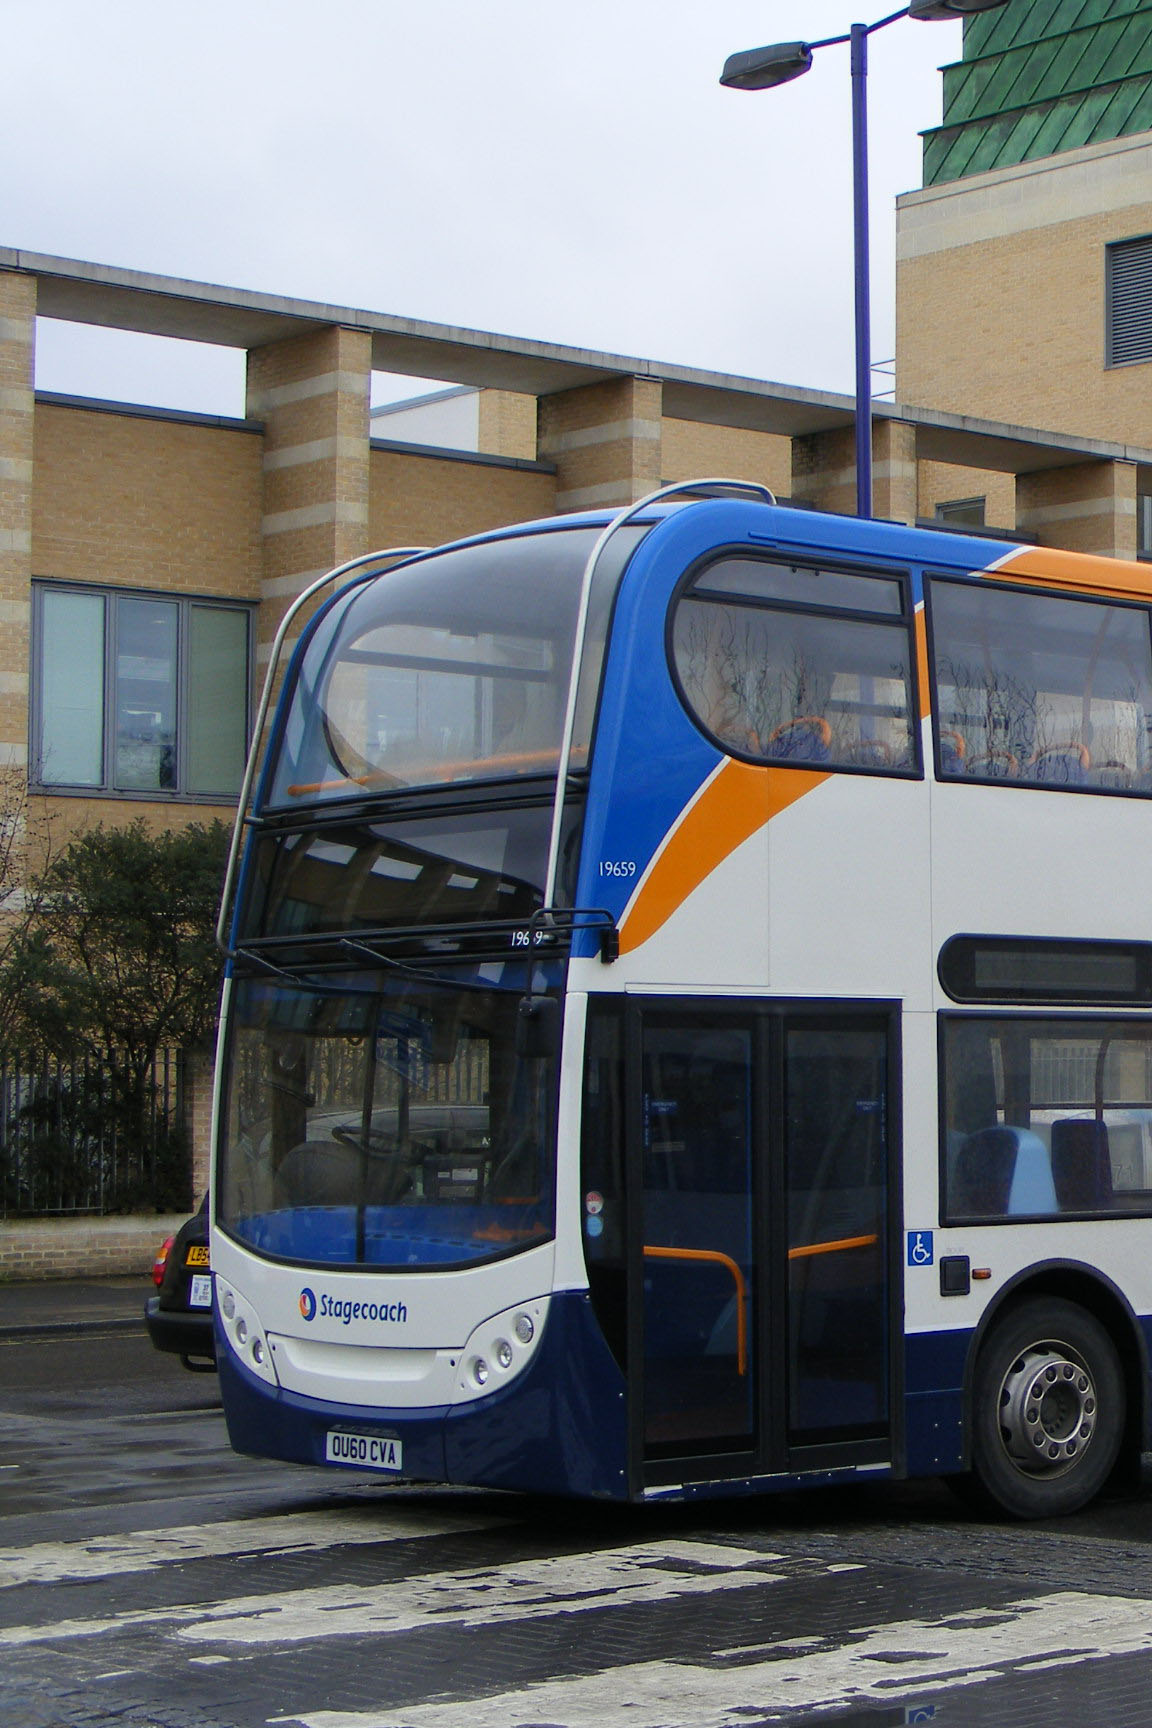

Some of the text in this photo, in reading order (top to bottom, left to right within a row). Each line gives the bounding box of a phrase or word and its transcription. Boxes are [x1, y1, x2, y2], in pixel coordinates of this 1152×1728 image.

[599, 861, 637, 877] 19659
[511, 931, 543, 946] 1969
[320, 1293, 407, 1324] Stagecoach
[332, 1435, 396, 1464] OU60 CVA
